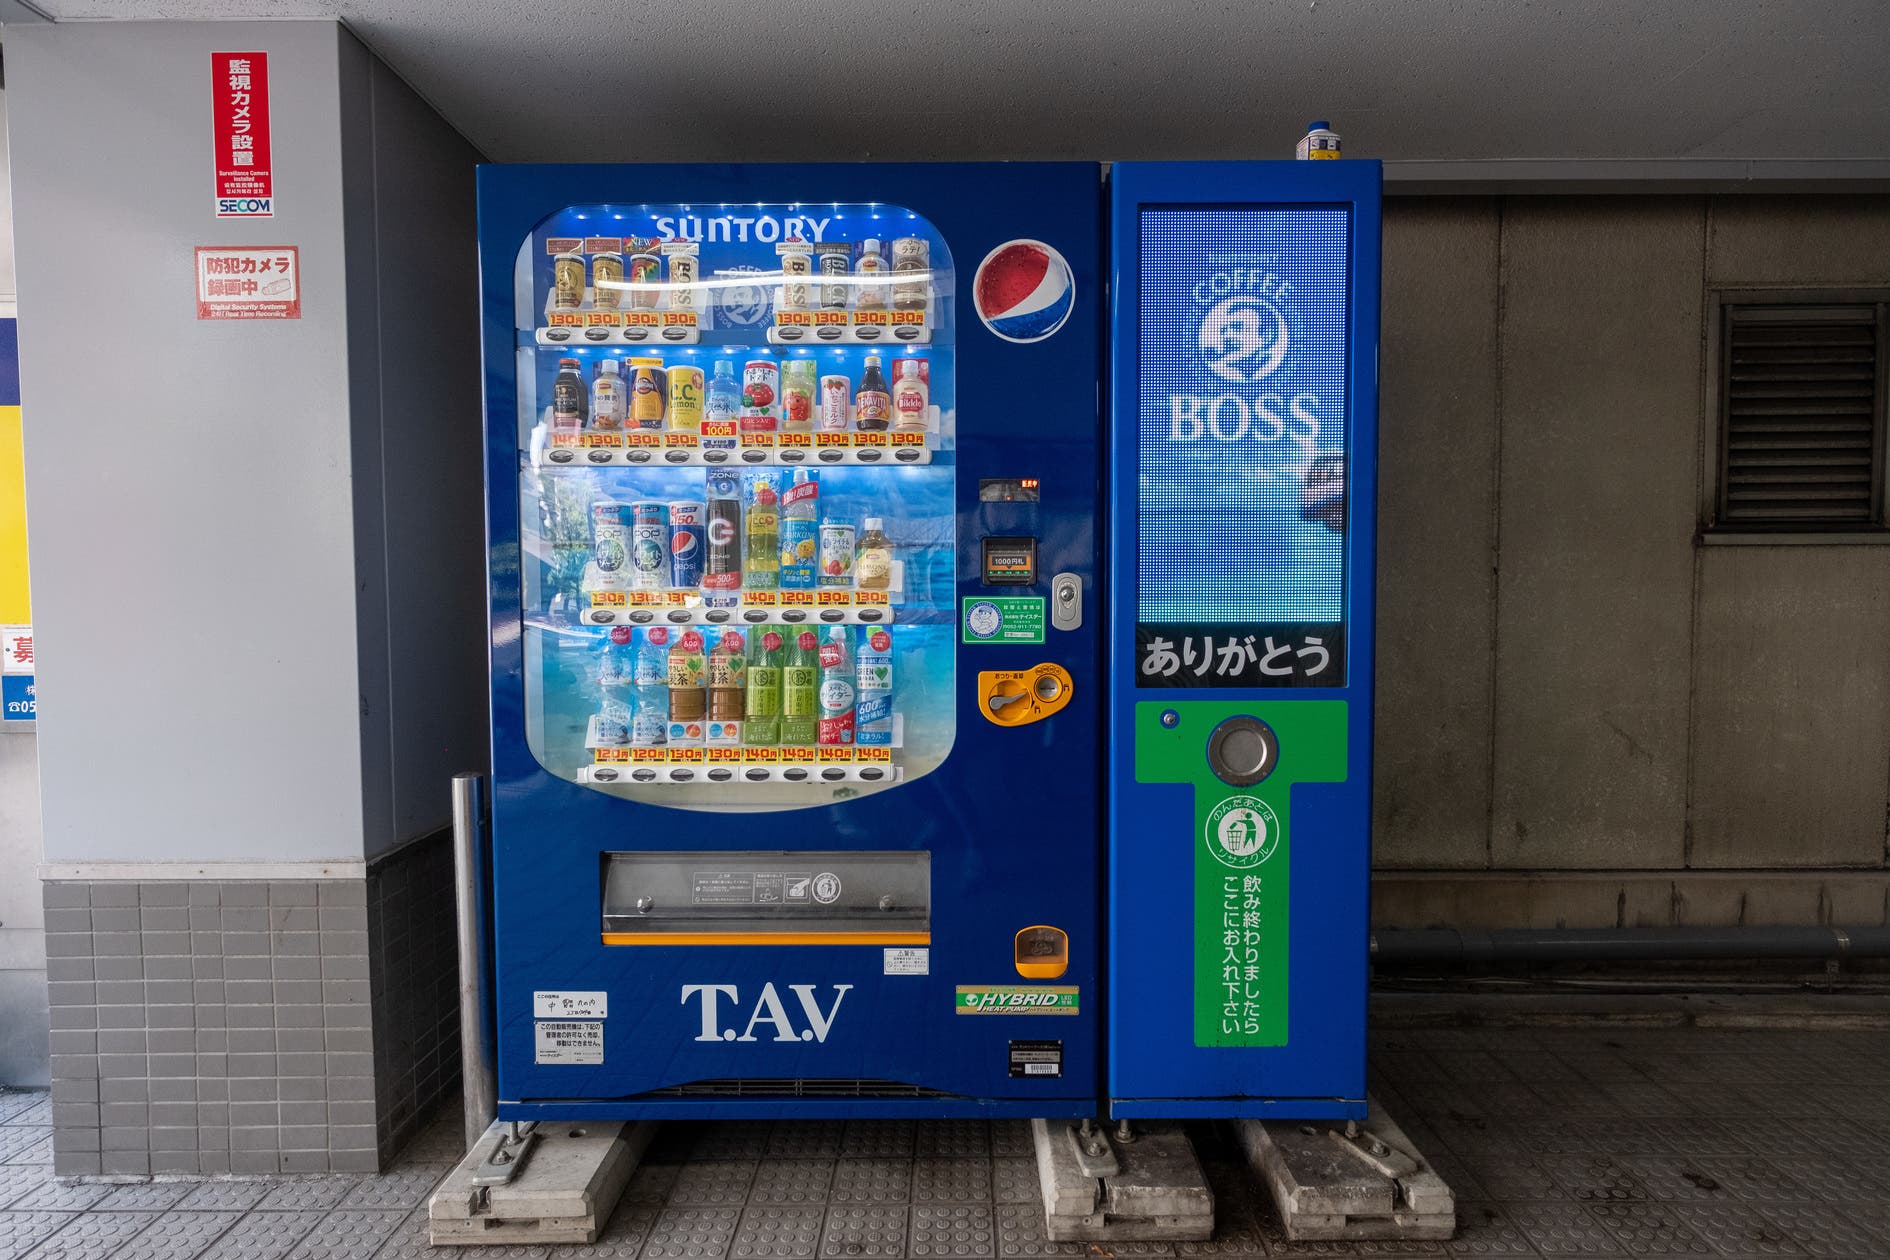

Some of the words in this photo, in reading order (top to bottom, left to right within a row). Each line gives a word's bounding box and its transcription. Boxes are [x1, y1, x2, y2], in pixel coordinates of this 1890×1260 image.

[228, 59, 254, 166] 監視カメラ設置
[219, 199, 270, 212] SECOM
[656, 217, 831, 243] SUNTORY
[206, 257, 290, 275] 防犯カメラ
[207, 278, 258, 296] 録画中
[830, 258, 847, 305] BLCK
[551, 314, 583, 325] 130円
[588, 314, 620, 325] 130円
[626, 313, 658, 325] 130円
[664, 313, 696, 324] 130円
[778, 313, 810, 324] 130円
[815, 313, 847, 324] 130円
[854, 313, 886, 323] 130円
[891, 313, 923, 323] 130円
[830, 389, 838, 425] いちごミルク
[1171, 393, 1319, 441] BOSS
[588, 434, 620, 444] 130円
[628, 434, 660, 444] 130円
[665, 434, 697, 444] 130円
[740, 434, 773, 444] 130円
[778, 434, 811, 443] 130円
[816, 434, 849, 443] 130円
[854, 434, 886, 443] 130円
[891, 434, 923, 443] 130円
[707, 426, 732, 436] 100円
[668, 593, 698, 602] 130
[744, 592, 776, 602] 140円
[781, 592, 813, 602] 120円
[818, 592, 850, 602] 130円
[856, 592, 888, 602] 130円
[1141, 636, 1330, 677] ありがとう
[668, 673, 688, 686] 麦茶
[709, 672, 729, 685] 麦茶
[597, 749, 629, 758] 120円
[634, 749, 665, 758] 120円
[670, 749, 702, 758] 130円
[709, 749, 741, 758] 130円
[746, 749, 777, 758] 140円
[782, 749, 814, 758] 140円
[820, 749, 852, 758] 140円
[858, 749, 889, 758] 140円
[1213, 797, 1273, 823] のんだあとは
[1216, 846, 1270, 866] リサイクル
[1222, 875, 1241, 1035] ここにお入れ下さい
[1243, 874, 1262, 1035] 飲み終わりましたら
[978, 993, 1059, 1008] HYBRID
[681, 981, 854, 1043] T.A.V
